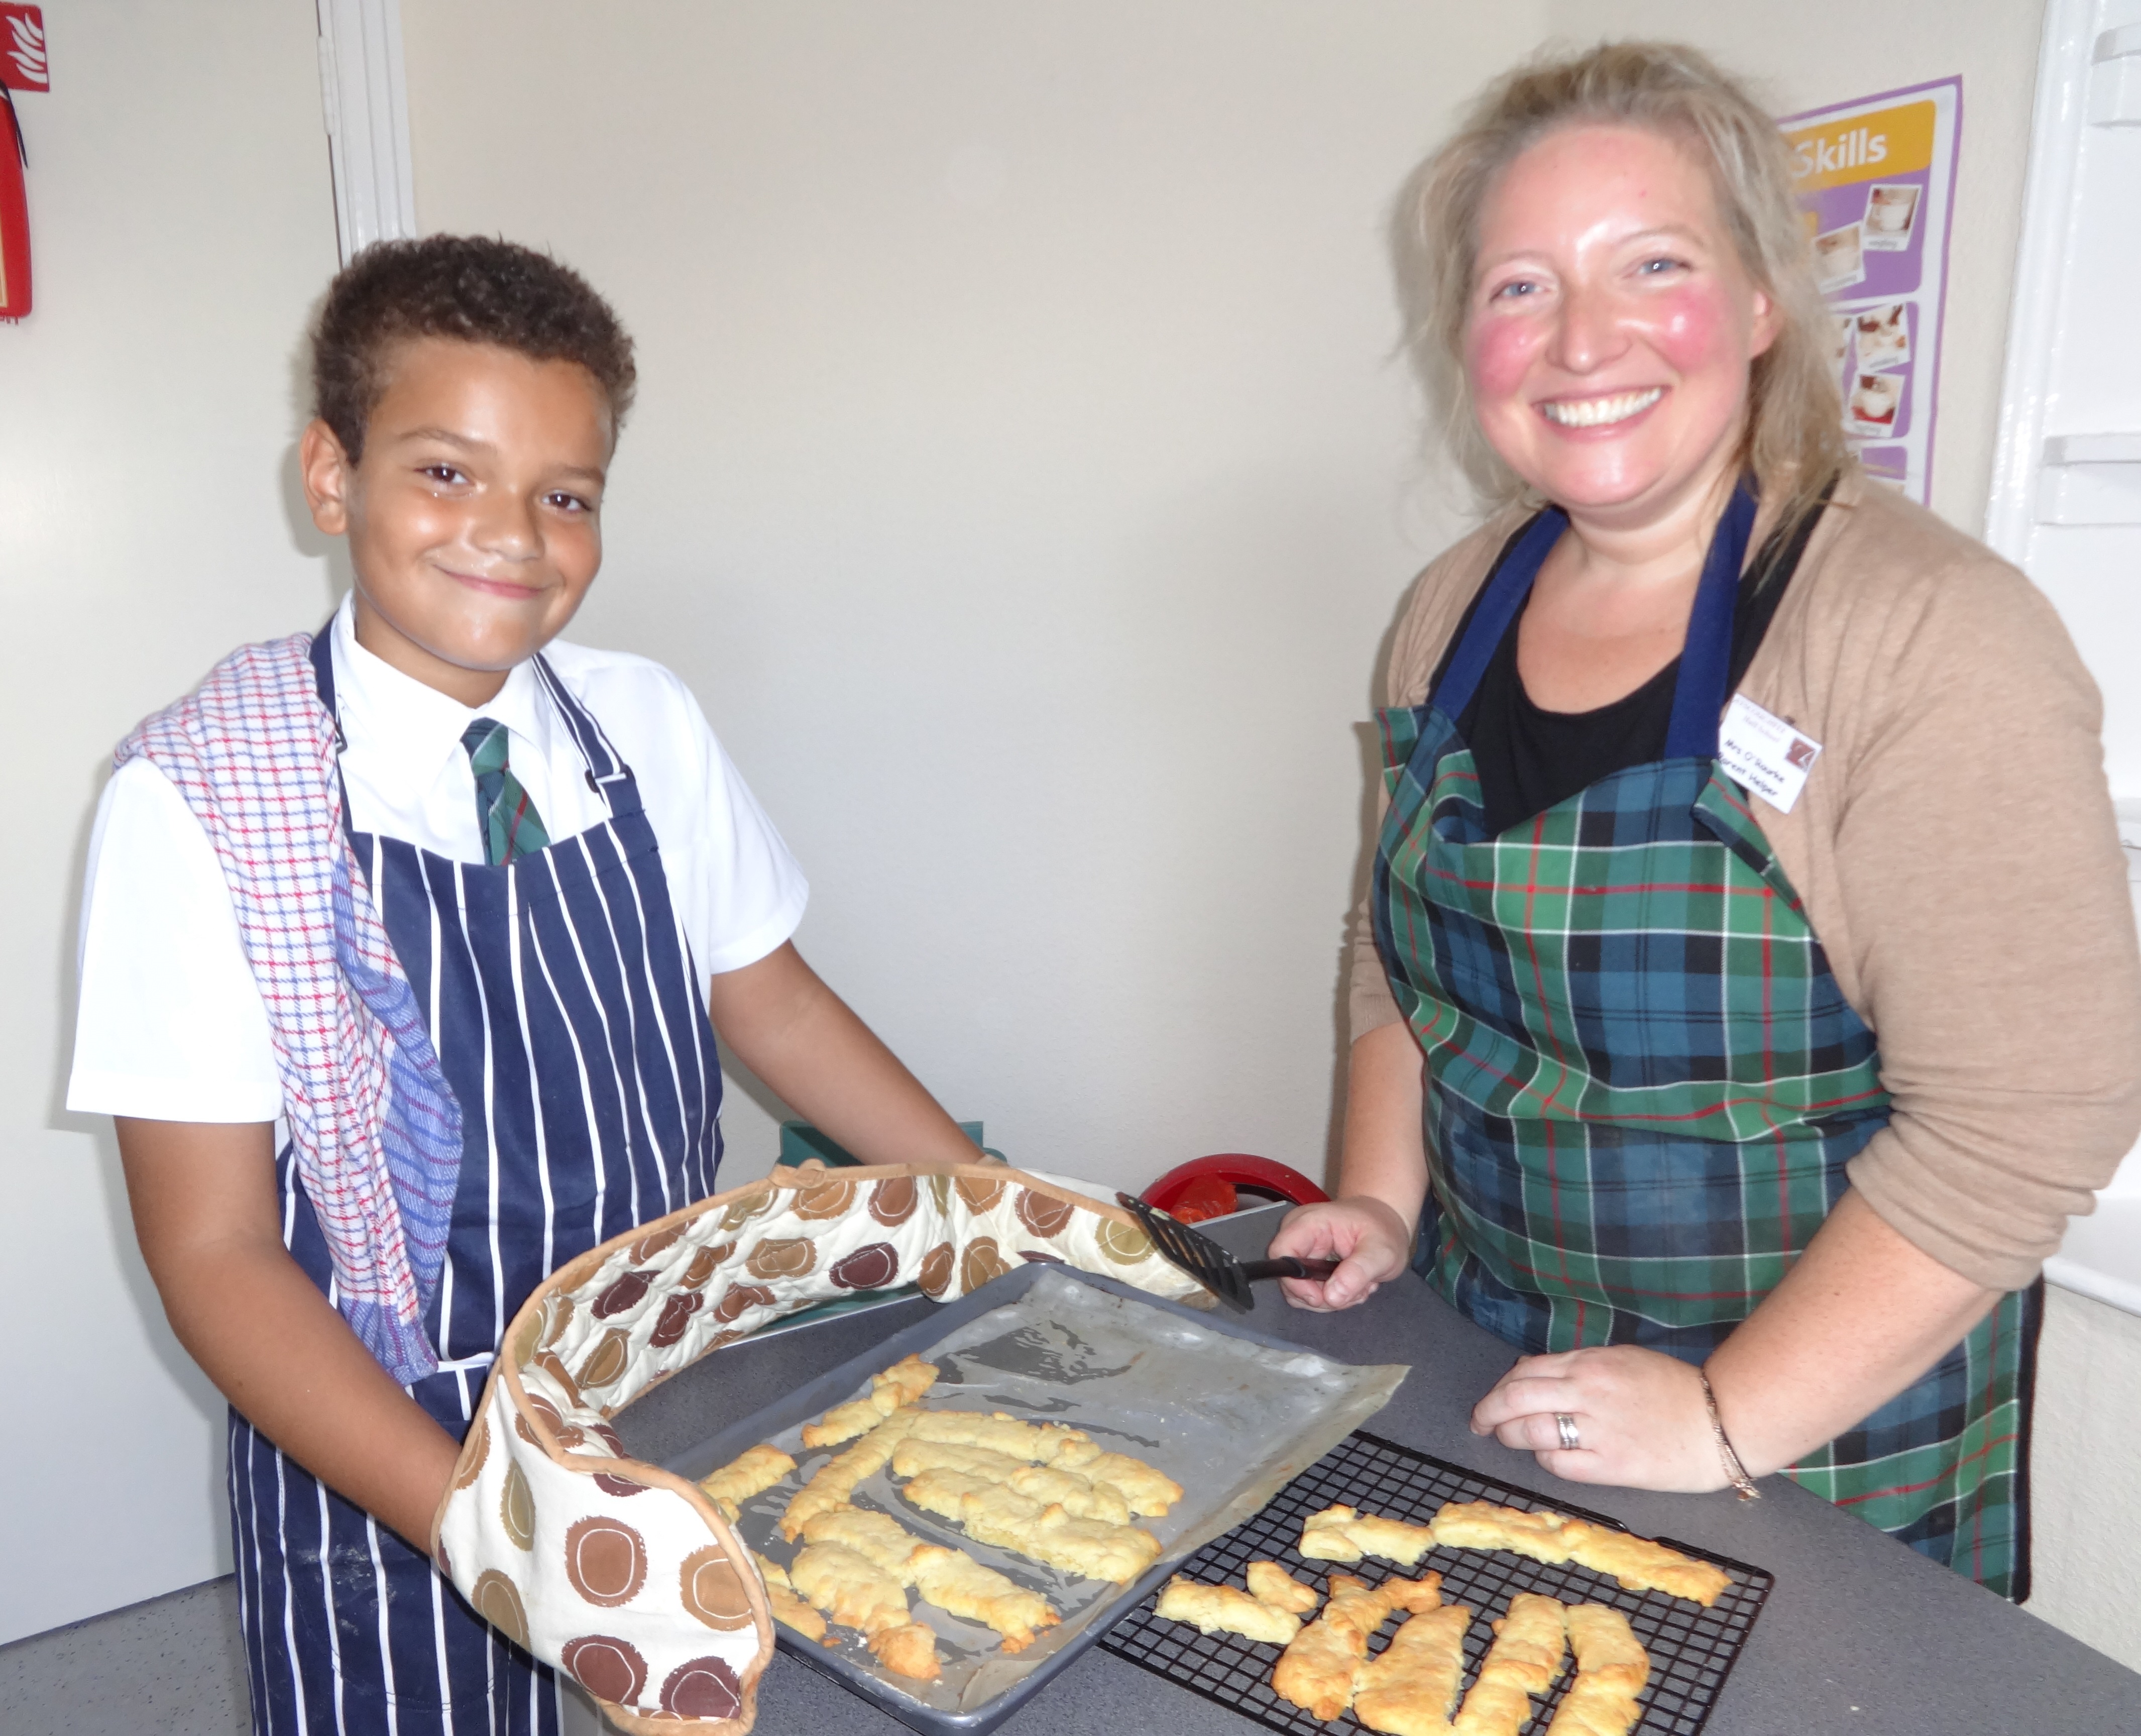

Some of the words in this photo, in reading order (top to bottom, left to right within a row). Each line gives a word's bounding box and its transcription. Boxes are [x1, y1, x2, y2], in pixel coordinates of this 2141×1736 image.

[1793, 128, 1887, 177] Skills
[1724, 738, 1741, 754] Mrs
[1749, 774, 1778, 795] Helper
